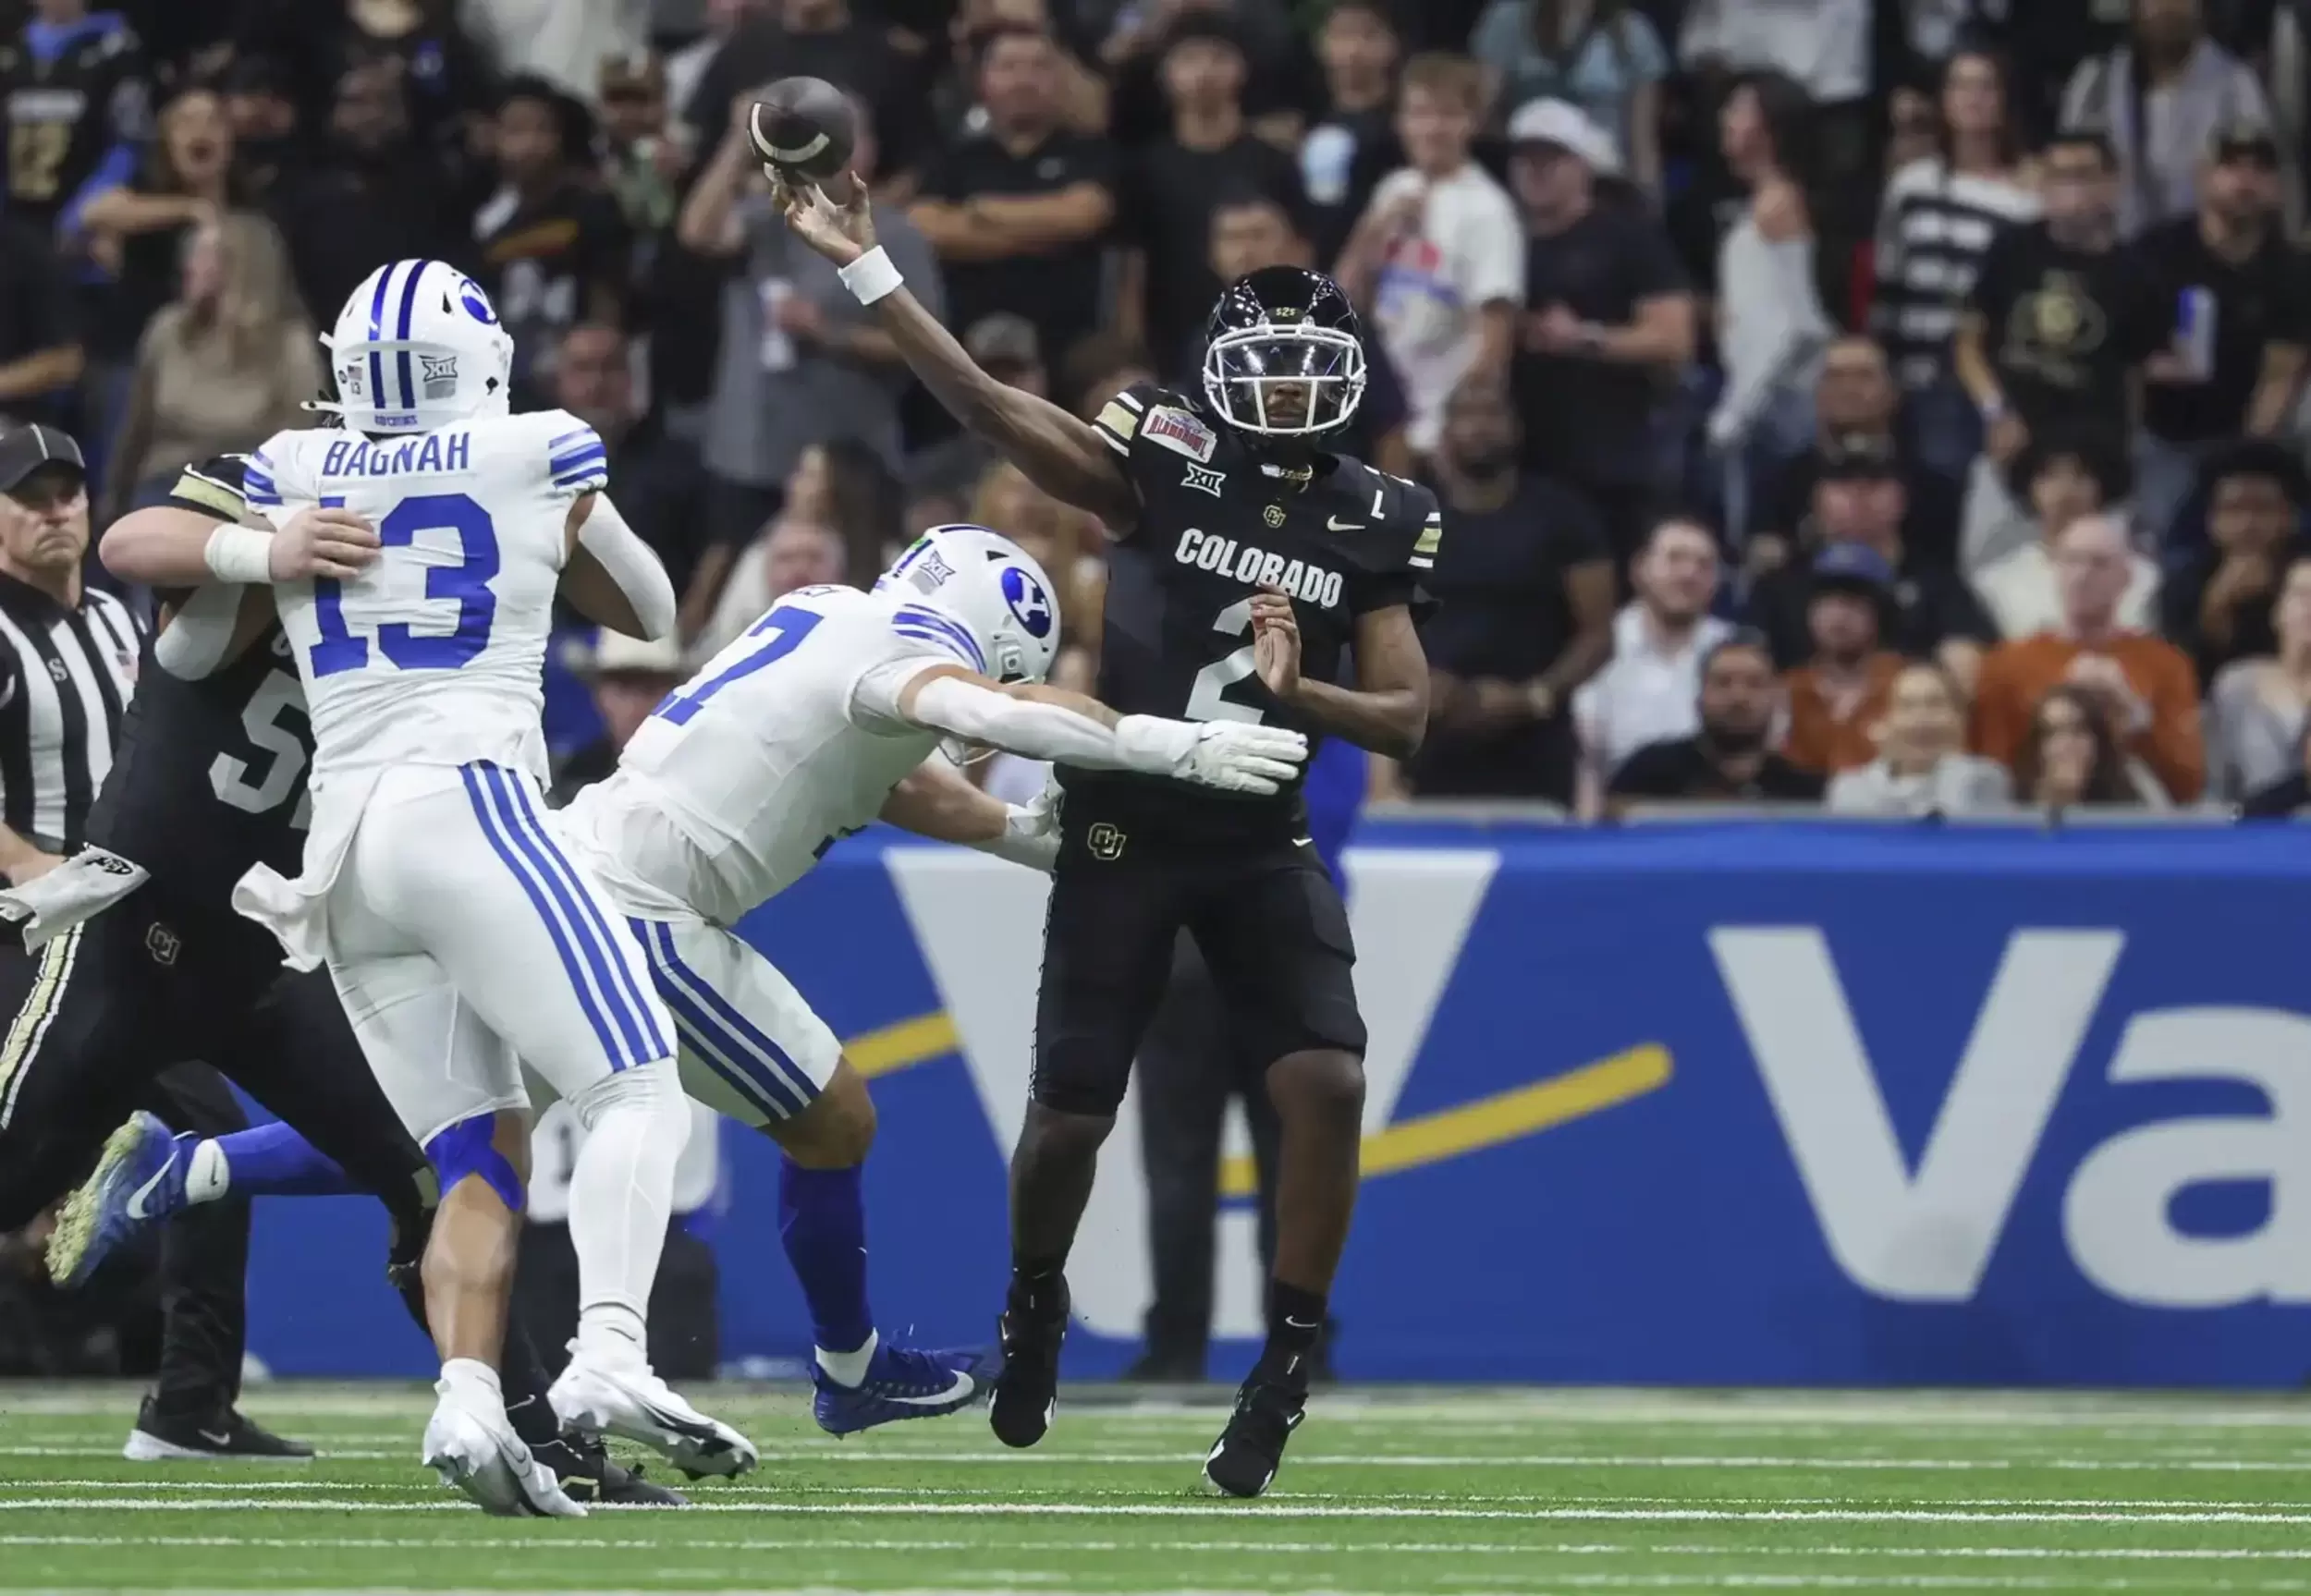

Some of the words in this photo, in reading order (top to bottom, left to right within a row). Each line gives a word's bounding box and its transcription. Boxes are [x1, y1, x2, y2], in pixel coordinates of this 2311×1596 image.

[322, 432, 470, 477] BAGNAH
[310, 493, 500, 679] 13
[1175, 528, 1343, 609] COLORADO
[48, 659, 67, 682] S
[1184, 594, 1265, 726] 2
[208, 667, 313, 831] 5
[1706, 926, 2311, 1309] Va
